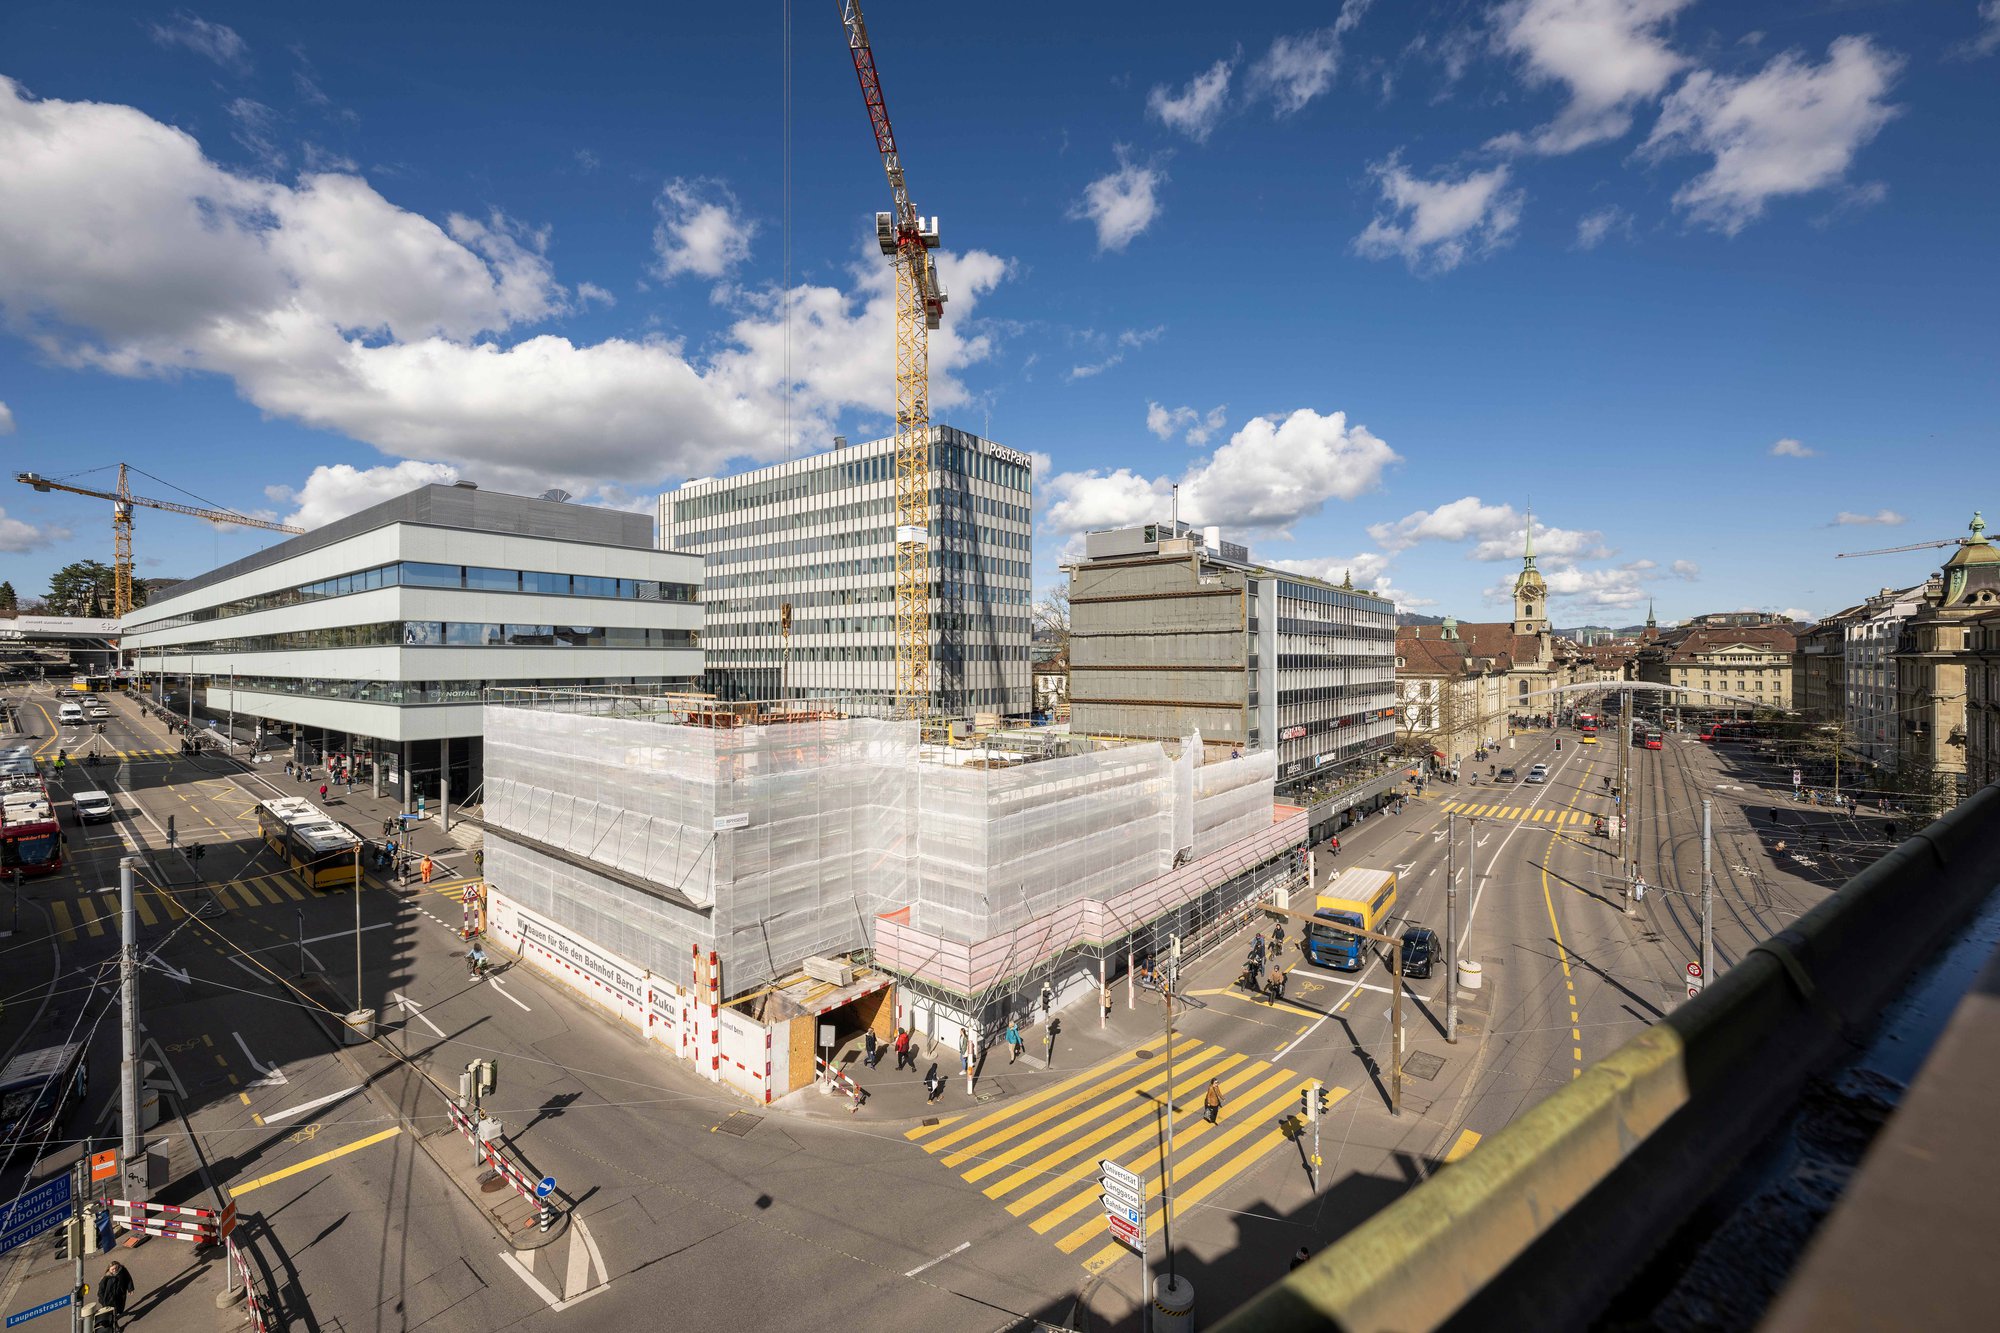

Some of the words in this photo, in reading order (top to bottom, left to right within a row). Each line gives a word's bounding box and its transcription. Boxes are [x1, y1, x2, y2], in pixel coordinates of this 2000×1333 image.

[990, 442, 1031, 468] PostParc
[446, 690, 477, 698] NOTFALL
[528, 925, 547, 941] bauen
[548, 934, 557, 947] für
[558, 940, 569, 954] Sie
[570, 949, 583, 963] den
[584, 955, 615, 980] Bahnhof
[616, 972, 635, 992] Bern
[1104, 1162, 1137, 1187] Universität
[0, 1187, 53, 1220] ausanne
[1105, 1180, 1138, 1204] Länggasse
[5, 1198, 53, 1229] ribourg
[1105, 1197, 1128, 1214] Bahnhof
[0, 1212, 63, 1252] Interlaken
[10, 1298, 68, 1324] Laupenstrasse
